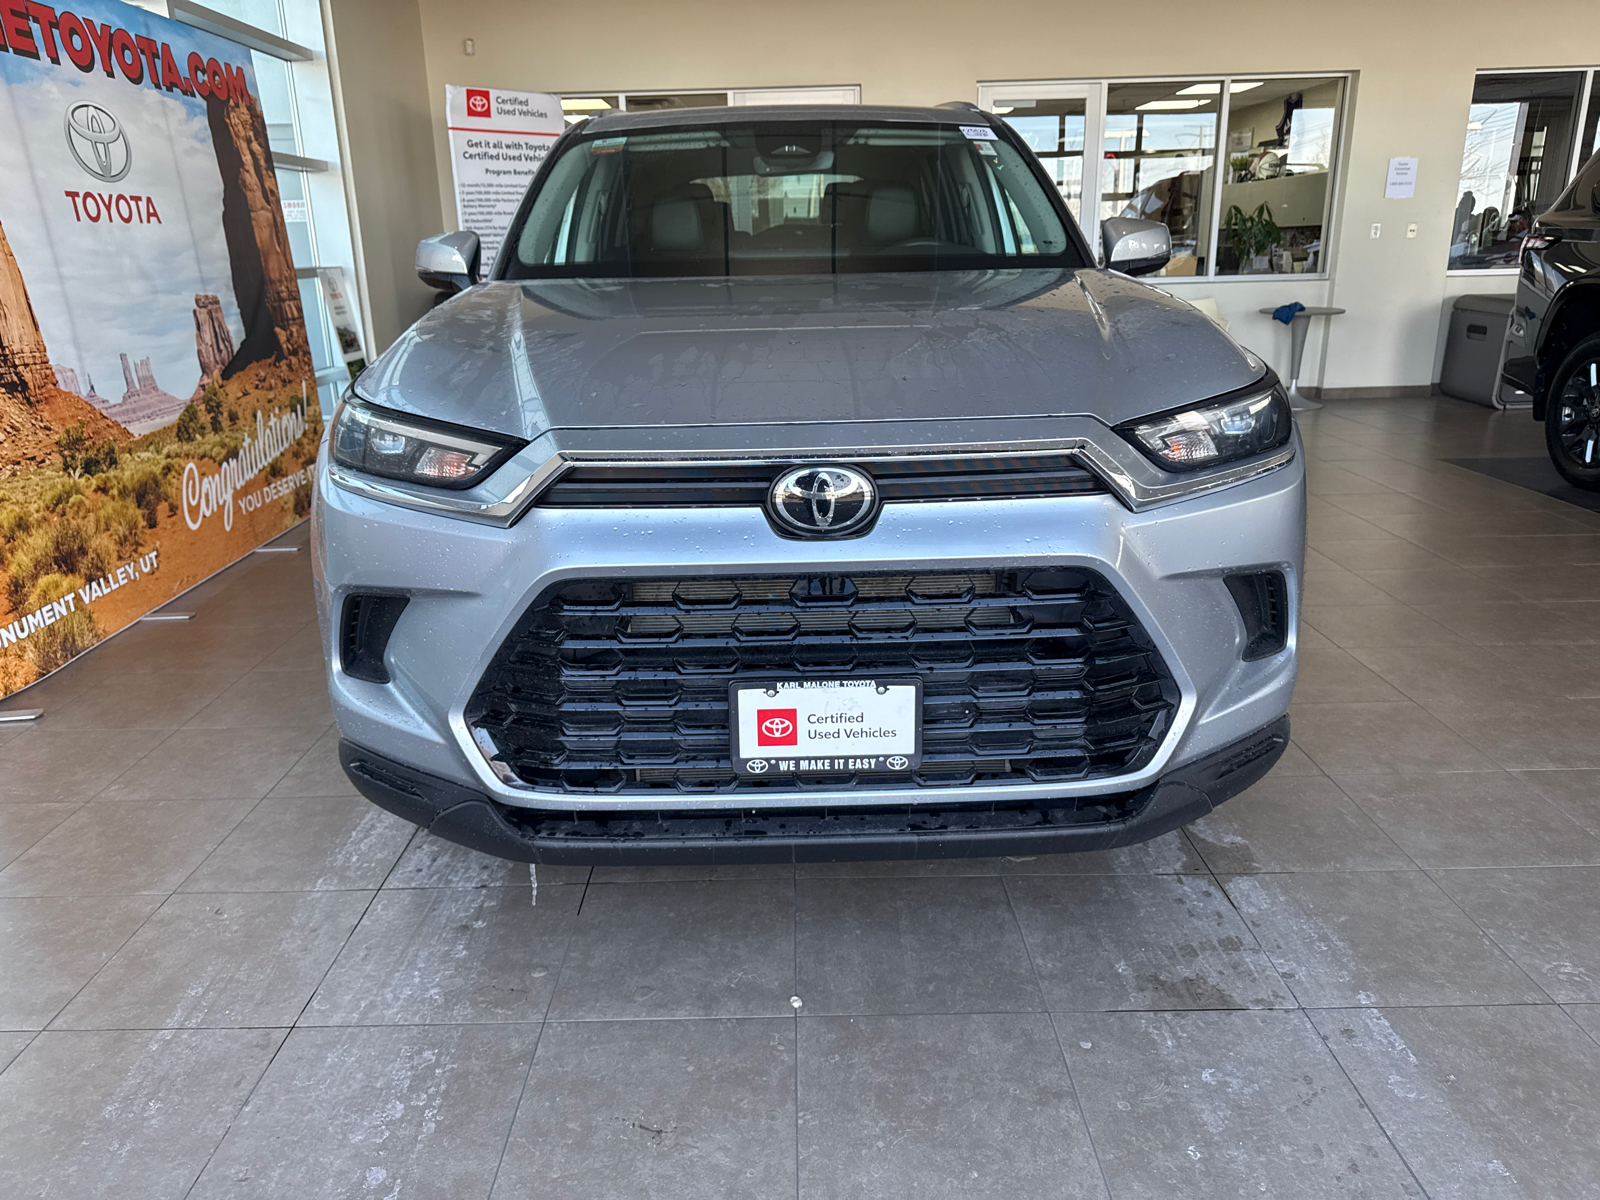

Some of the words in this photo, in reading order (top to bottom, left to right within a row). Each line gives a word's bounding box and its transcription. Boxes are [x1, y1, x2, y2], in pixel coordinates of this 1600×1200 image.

[0, 0, 251, 104] ETOYOTA.COM
[495, 96, 529, 106] Certified
[496, 107, 516, 116] Used
[517, 108, 548, 119] Vehicles
[466, 139, 483, 148] Get
[484, 140, 491, 149] it
[492, 140, 503, 149] all
[504, 141, 523, 150] with
[462, 151, 500, 160] Certified
[501, 152, 522, 161] Used
[485, 168, 512, 176] Program
[64, 190, 162, 225] TOYOTA
[182, 380, 308, 532] Congratulations!
[238, 490, 262, 515] YOU
[263, 469, 307, 504] DESERVE
[0, 592, 75, 649] NUMENT
[78, 561, 139, 605] VALLEY,
[139, 550, 158, 573] UT
[776, 681, 802, 690] KARL
[803, 680, 840, 689] MALONE
[842, 680, 877, 689] TOYOTA
[807, 712, 864, 724] Certified
[807, 728, 841, 740] Used
[843, 727, 897, 739] Vehicles
[778, 760, 796, 771] WE
[799, 759, 831, 770] MAKE
[834, 759, 845, 770] IT
[848, 758, 877, 769] EASY
